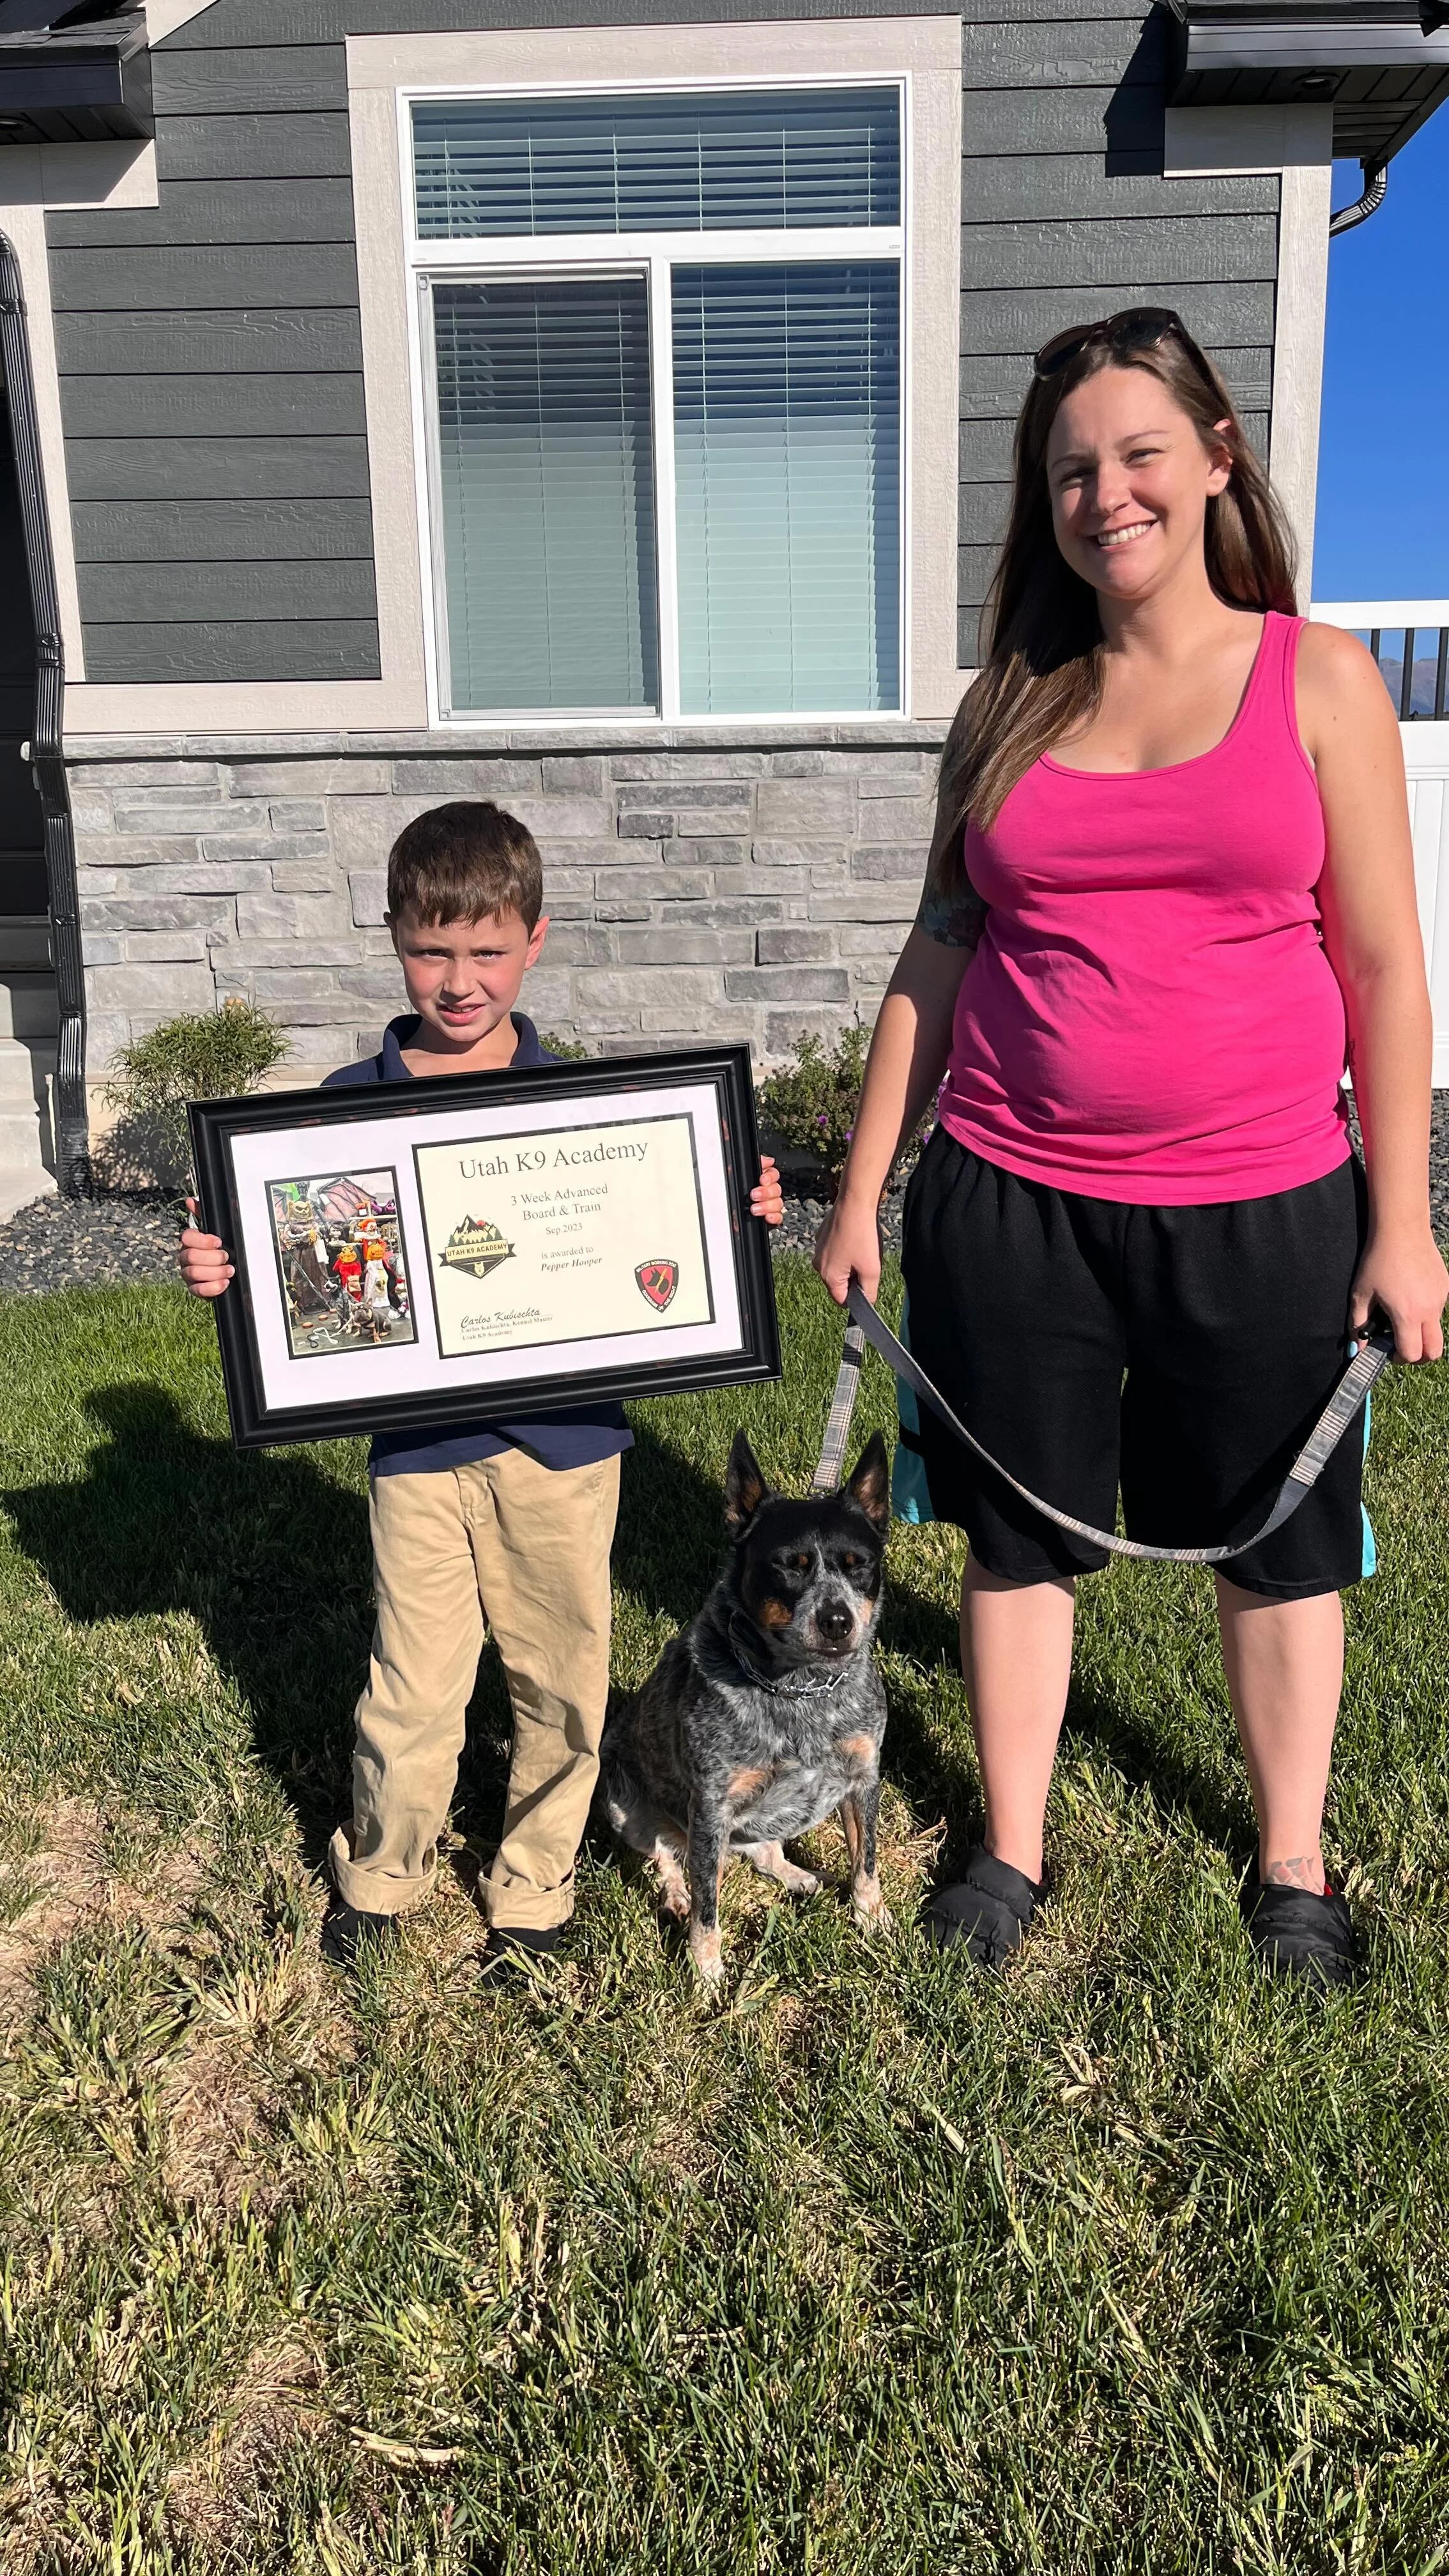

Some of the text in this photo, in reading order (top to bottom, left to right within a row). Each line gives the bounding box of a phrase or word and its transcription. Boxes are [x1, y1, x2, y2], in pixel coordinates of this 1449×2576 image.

[459, 1142, 648, 1179] Utah K9 Academy
[510, 1183, 608, 1206] 3 Week Advanced
[523, 1202, 602, 1221] Board & Train
[546, 1222, 583, 1236] Sep 2023
[447, 1248, 465, 1257] UTAH
[476, 1243, 507, 1253] ACADEMY
[541, 1251, 548, 1260] is
[550, 1246, 584, 1258] awarded
[541, 1257, 603, 1273] Pepper Hooper
[461, 1307, 541, 1328] Carlos Kubischta
[487, 1330, 512, 1338] Academy
